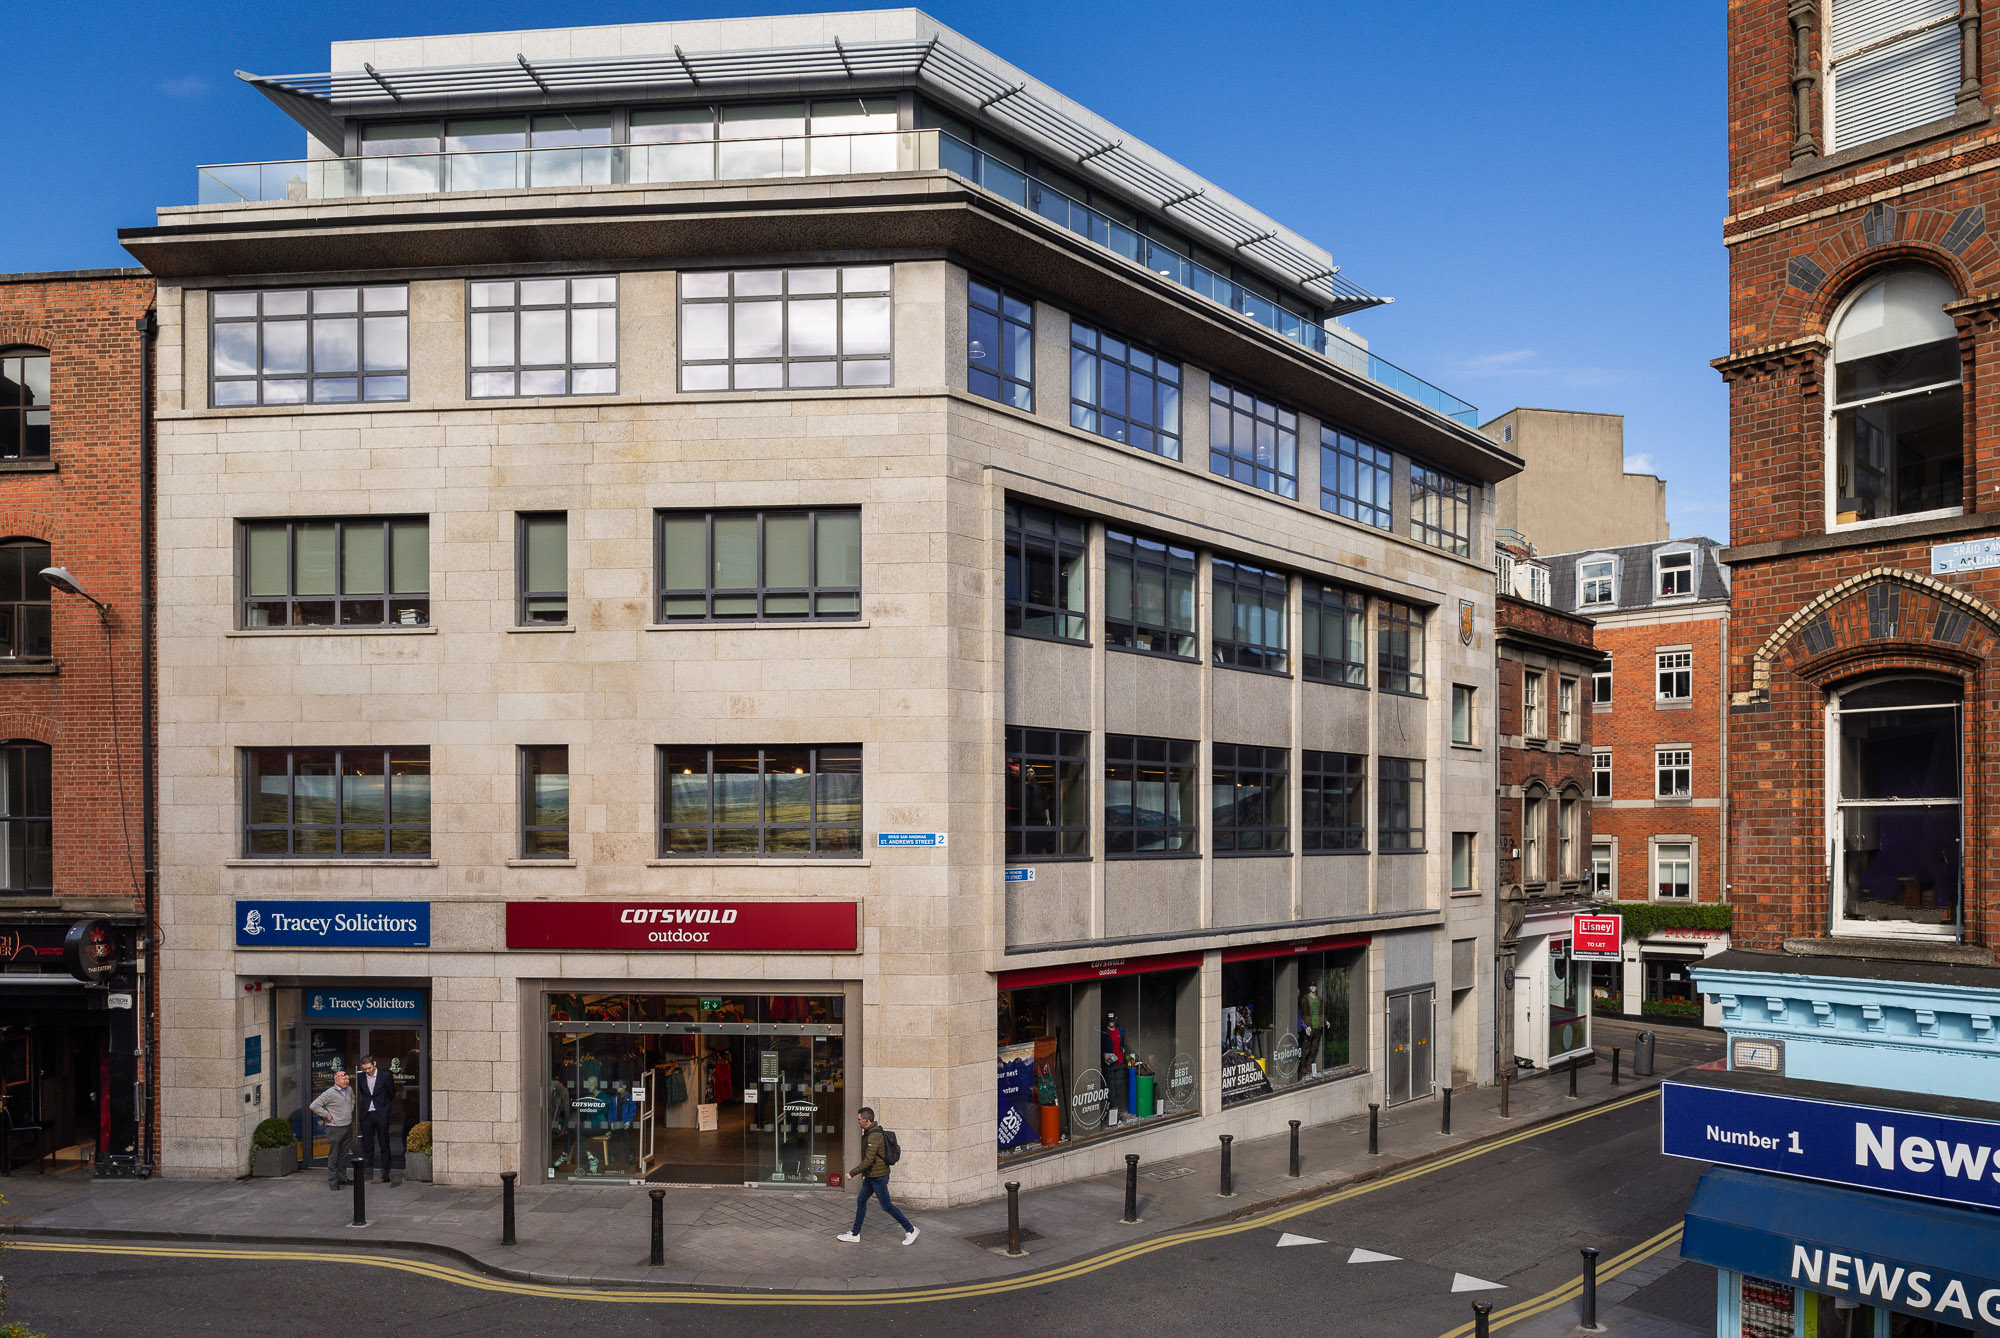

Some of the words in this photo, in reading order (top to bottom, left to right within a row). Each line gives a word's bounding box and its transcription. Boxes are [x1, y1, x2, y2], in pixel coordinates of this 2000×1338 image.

[938, 835, 944, 844] 2
[1029, 870, 1033, 879] 2
[620, 909, 738, 923] COTSWOLD
[272, 914, 332, 935] Tracey
[335, 914, 417, 932] Solicitors
[1582, 922, 1611, 933] Lisney
[648, 928, 710, 942] outdoor
[1665, 927, 1723, 940] PICHET
[1098, 968, 1117, 976] outdoor
[329, 997, 364, 1011] Tracey
[366, 997, 415, 1009] Solicitors
[1273, 1047, 1302, 1062] Exploring
[1006, 1069, 1018, 1077] next
[1175, 1067, 1189, 1078] BEST
[1222, 1066, 1237, 1079] ANY
[1237, 1062, 1257, 1074] TRAIL
[1171, 1075, 1192, 1088] BRANDS
[1222, 1077, 1237, 1090] ANY
[1072, 1088, 1109, 1106] OUTDOOR
[1082, 1103, 1099, 1114] EXPERTS
[1706, 1124, 1780, 1150] Number
[1788, 1131, 1804, 1154] 1
[1855, 1122, 2000, 1184] New
